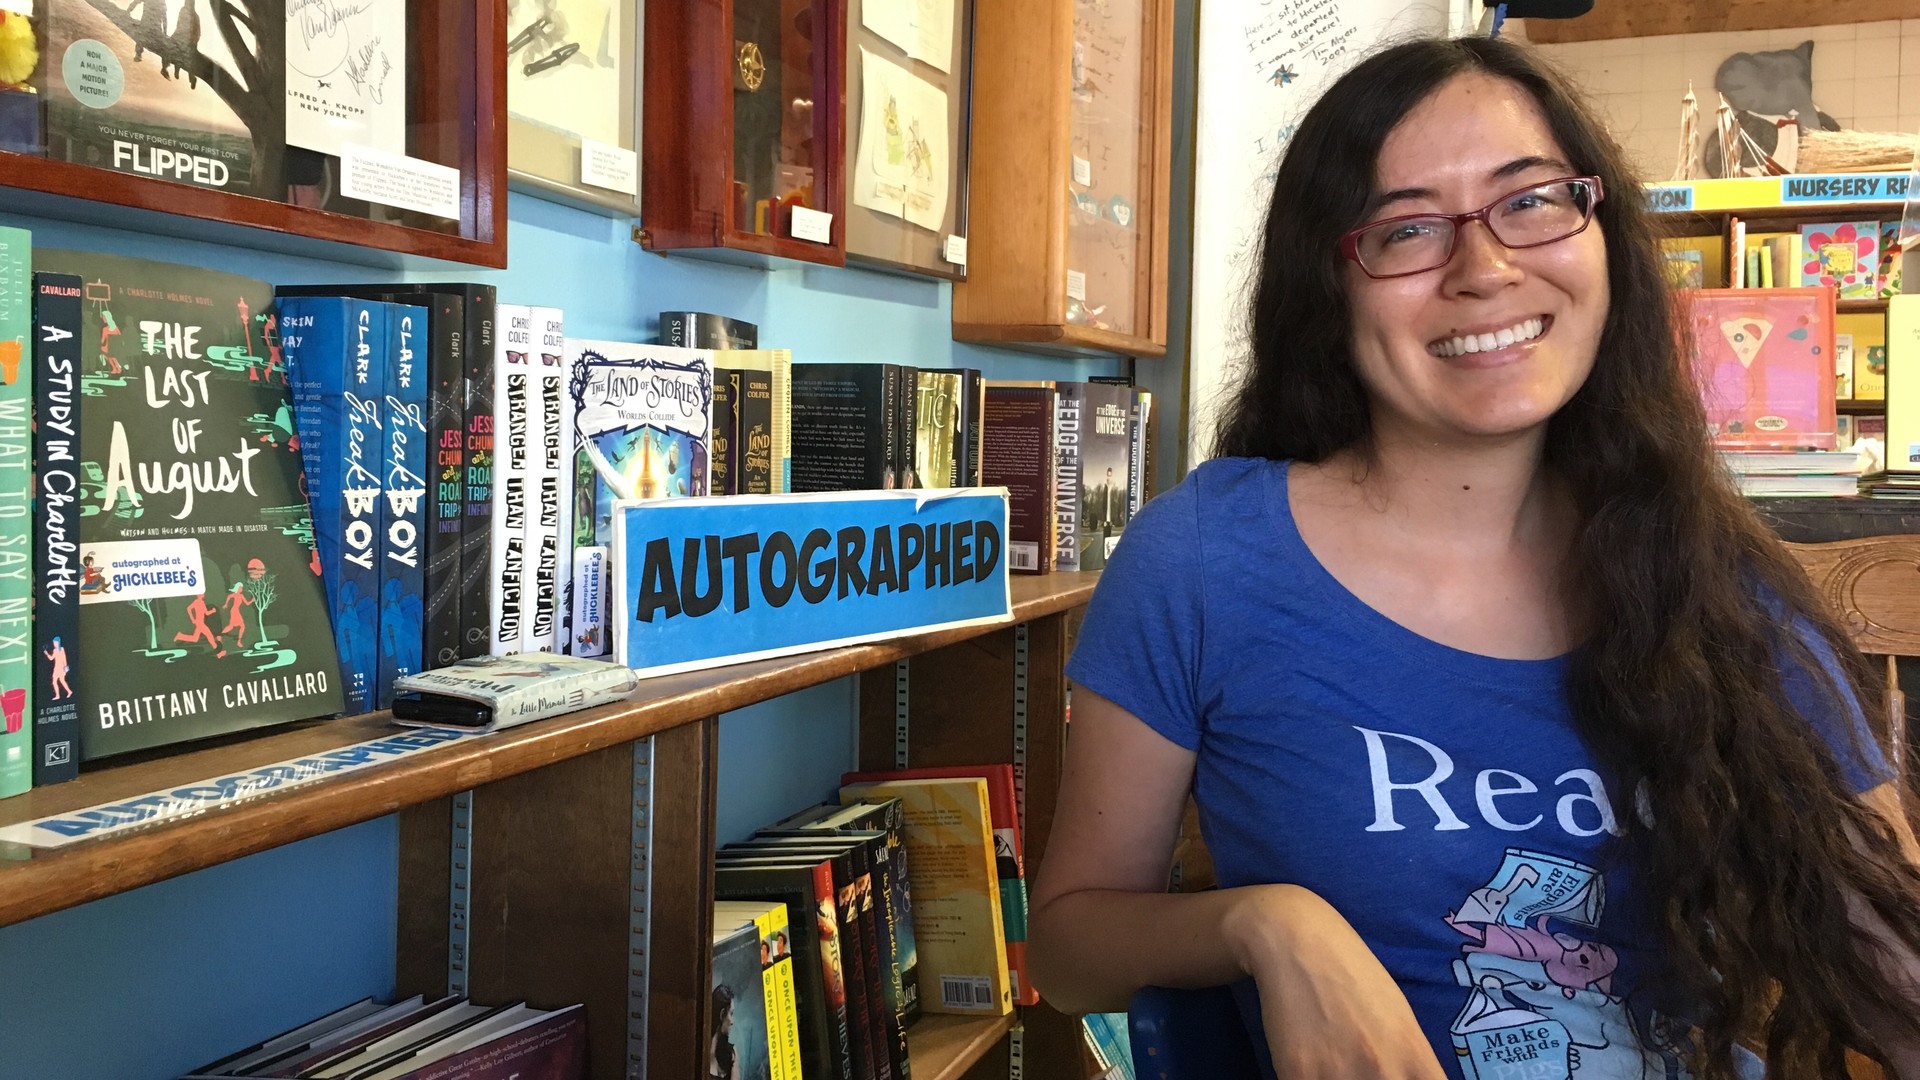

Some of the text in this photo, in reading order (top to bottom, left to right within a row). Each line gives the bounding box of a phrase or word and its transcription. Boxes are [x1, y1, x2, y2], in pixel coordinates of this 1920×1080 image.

[1244, 22, 1264, 38] Here
[86, 50, 101, 60] NOW
[1246, 40, 1257, 53] I
[1320, 46, 1346, 66] 2009
[80, 61, 108, 74] A MAJOR
[1254, 61, 1266, 74] I
[82, 74, 106, 85] MOTION
[288, 89, 318, 103] LFRED
[335, 102, 365, 115] KNOPF
[300, 102, 348, 120] NEW YORK
[98, 125, 220, 157] YOU NEVER FORGET YOUR FIRST
[113, 139, 229, 187] FLIPPED
[1788, 177, 1910, 197] NURSERY RH
[0, 242, 9, 321] BUXBAUM
[12, 259, 23, 307] JULIE
[40, 285, 81, 298] CAVALLARO
[119, 287, 214, 307] A CHARLOTTE HOLMES NOVEL
[282, 316, 314, 327] SKIN
[139, 320, 203, 360] THE
[482, 319, 492, 346] Clark
[508, 331, 529, 344] COLFE
[357, 309, 370, 385] CLARK
[399, 316, 413, 389] CLARK
[452, 332, 460, 358] Clark
[144, 365, 211, 409] LAST
[304, 381, 322, 390] perfect
[589, 368, 700, 418] THE LAND OF STORIES
[747, 391, 770, 399] COLFER
[750, 382, 768, 390] CHRIS
[306, 393, 322, 402] gentle
[1068, 400, 1080, 408] THE
[300, 405, 321, 413] Brendan
[617, 410, 676, 421] WORLDS COLLIDE
[1105, 404, 1117, 416] EDGE
[172, 417, 203, 454] OF
[1059, 408, 1080, 456] EDGE
[1095, 416, 1126, 435] UNIVERSE
[745, 431, 770, 457] LAND
[41, 325, 78, 605] A STUDY IN Charlotte
[471, 450, 485, 465] and
[745, 459, 770, 474] STORIES
[1066, 457, 1077, 465] THE
[102, 420, 261, 520] August
[442, 465, 456, 480] and
[308, 478, 320, 486] with
[467, 486, 488, 501] TRIP
[438, 502, 457, 518] TRIP
[499, 374, 527, 643] STRANGER THAN FANFICTION
[533, 375, 561, 637] STRANGER THAN FANFICTION
[1056, 466, 1077, 559] UNIVERSE
[0, 398, 27, 665] WHAT TO SAY NEXT
[120, 528, 145, 538] WATSON
[147, 527, 160, 536] AND
[191, 526, 196, 534] A
[197, 524, 216, 534] MATCH
[218, 524, 234, 534] MADE
[235, 524, 243, 533] IN
[243, 523, 269, 533] DISASTER
[343, 487, 382, 571] BOY
[384, 487, 426, 569] BOY
[112, 557, 181, 569] autographed at
[636, 519, 1000, 623] AUTOGRAPHED
[112, 566, 197, 592] HICKLEBEE'S
[589, 551, 602, 624] HICKLEBEE'S
[581, 564, 590, 623] autographed at
[46, 703, 76, 715] CHARLOTTE
[99, 671, 328, 730] BRITTANY CAVALLARO
[37, 712, 78, 725] HOLMES NOVEL
[1351, 725, 1656, 839] Rea
[1514, 866, 1582, 925] Elephants are
[767, 989, 778, 1058] ONCE UPON
[782, 980, 797, 1071] ONCE UPON THE
[838, 1005, 850, 1080] THIEVES
[1482, 1026, 1551, 1050] Make
[1480, 1040, 1560, 1063] Friends
[1502, 1051, 1539, 1065] with
[448, 1062, 463, 1072] Great
[1493, 1059, 1564, 1080] Pigs
